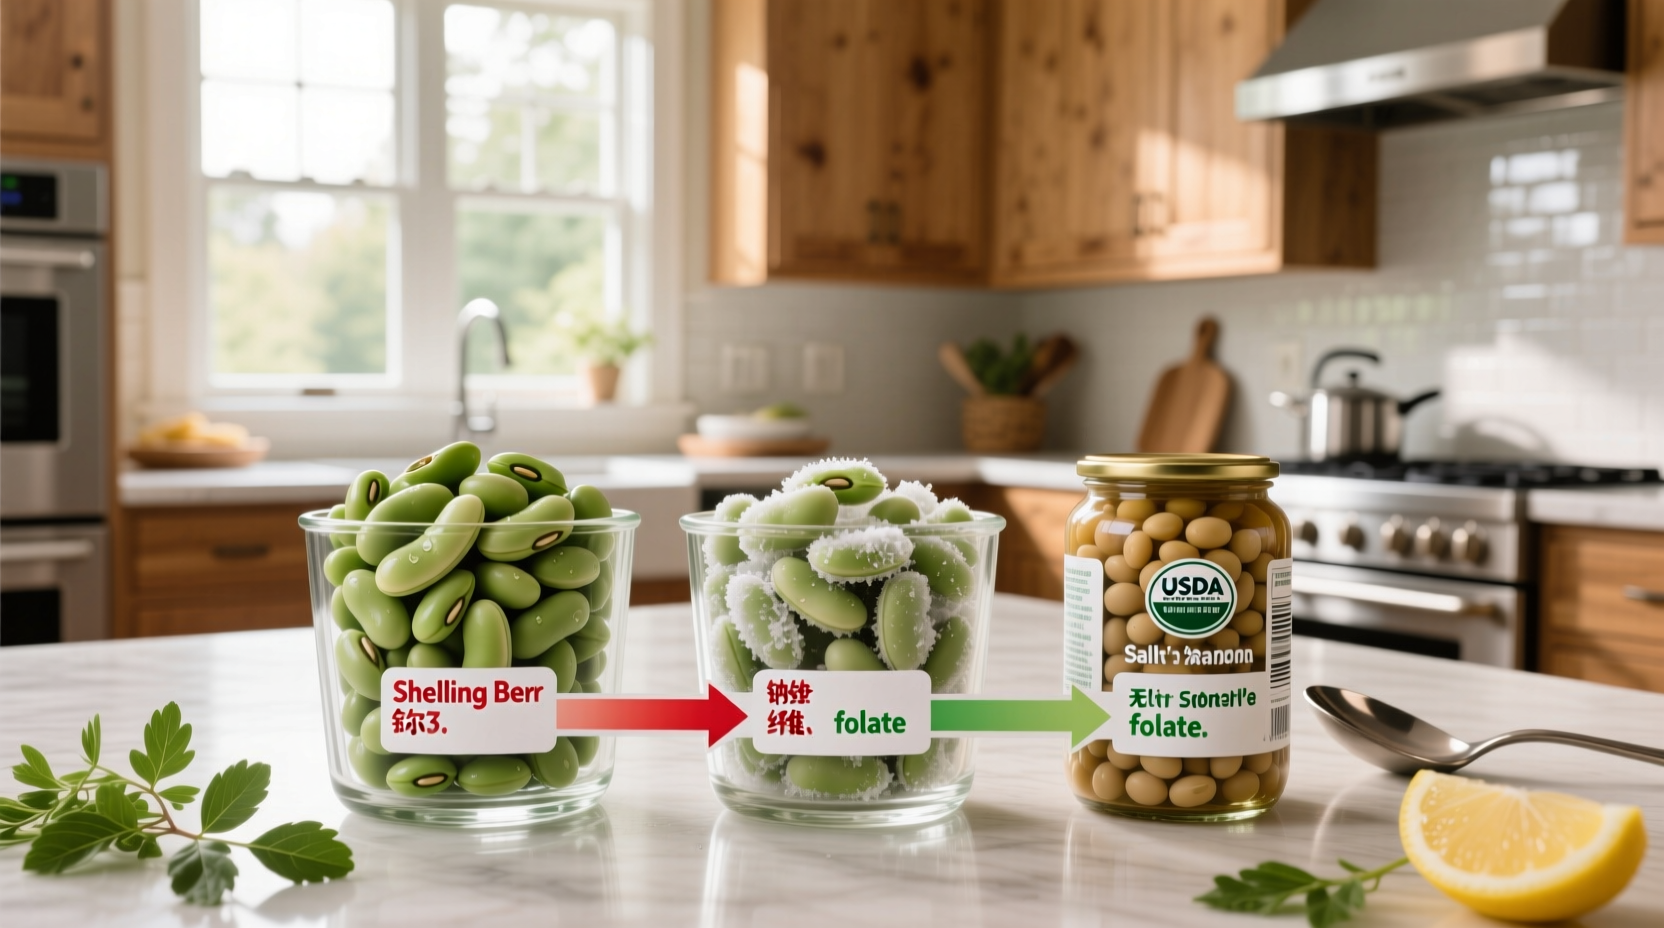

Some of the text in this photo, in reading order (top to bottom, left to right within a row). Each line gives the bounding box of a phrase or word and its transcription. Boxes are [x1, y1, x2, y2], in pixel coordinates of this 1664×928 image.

[1161, 576, 1224, 596] USDA
[393, 679, 544, 710] Shelling Berr
[834, 709, 907, 734] folate
[1129, 713, 1208, 738] folate.
